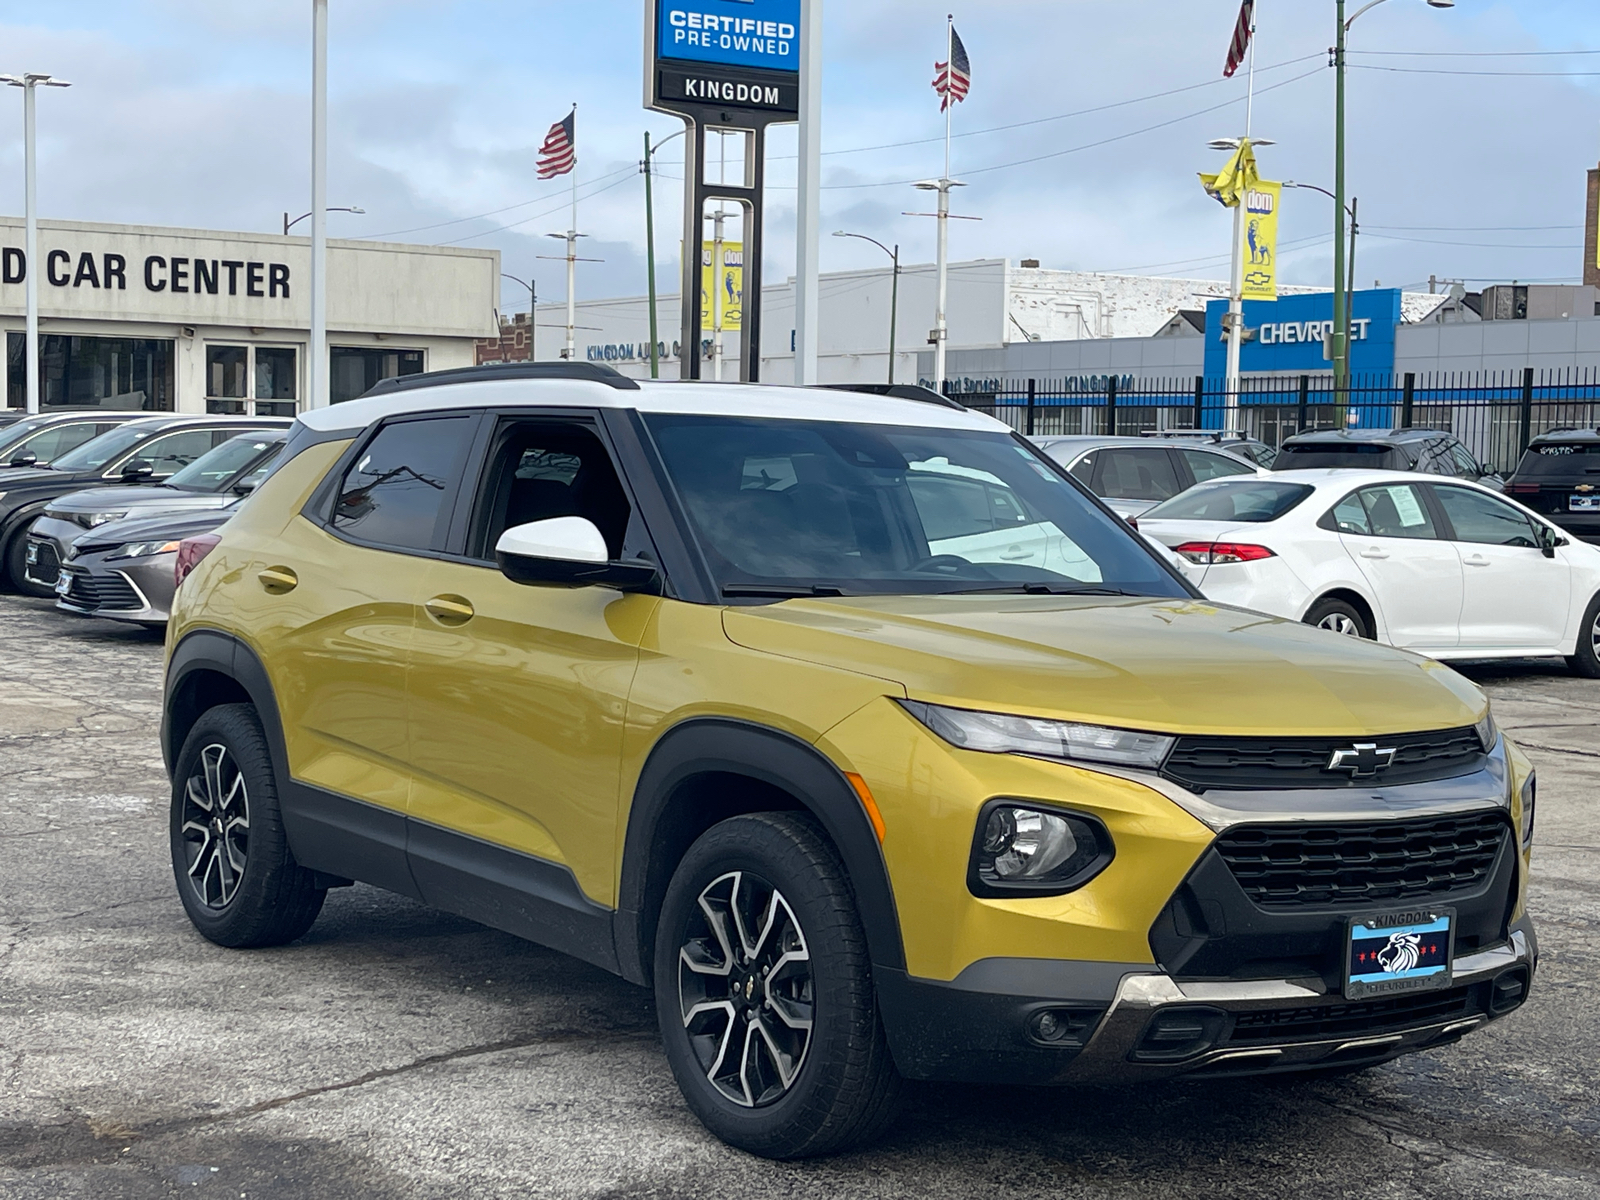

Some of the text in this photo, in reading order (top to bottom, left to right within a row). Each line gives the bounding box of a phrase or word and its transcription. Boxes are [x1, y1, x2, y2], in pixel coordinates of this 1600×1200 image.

[669, 10, 795, 39] CERTIFIED
[674, 29, 790, 56] PRE-OWNED
[685, 78, 779, 105] KINGDOM
[1247, 188, 1273, 213] dom
[47, 249, 127, 290] CAR
[144, 255, 291, 298] CENTER
[1260, 318, 1371, 345] CHEVROET
[587, 343, 635, 361] KINGDOM
[637, 340, 670, 360] AUO
[1375, 911, 1431, 927] KINGDOM
[1369, 979, 1426, 993] CHEVROLET
